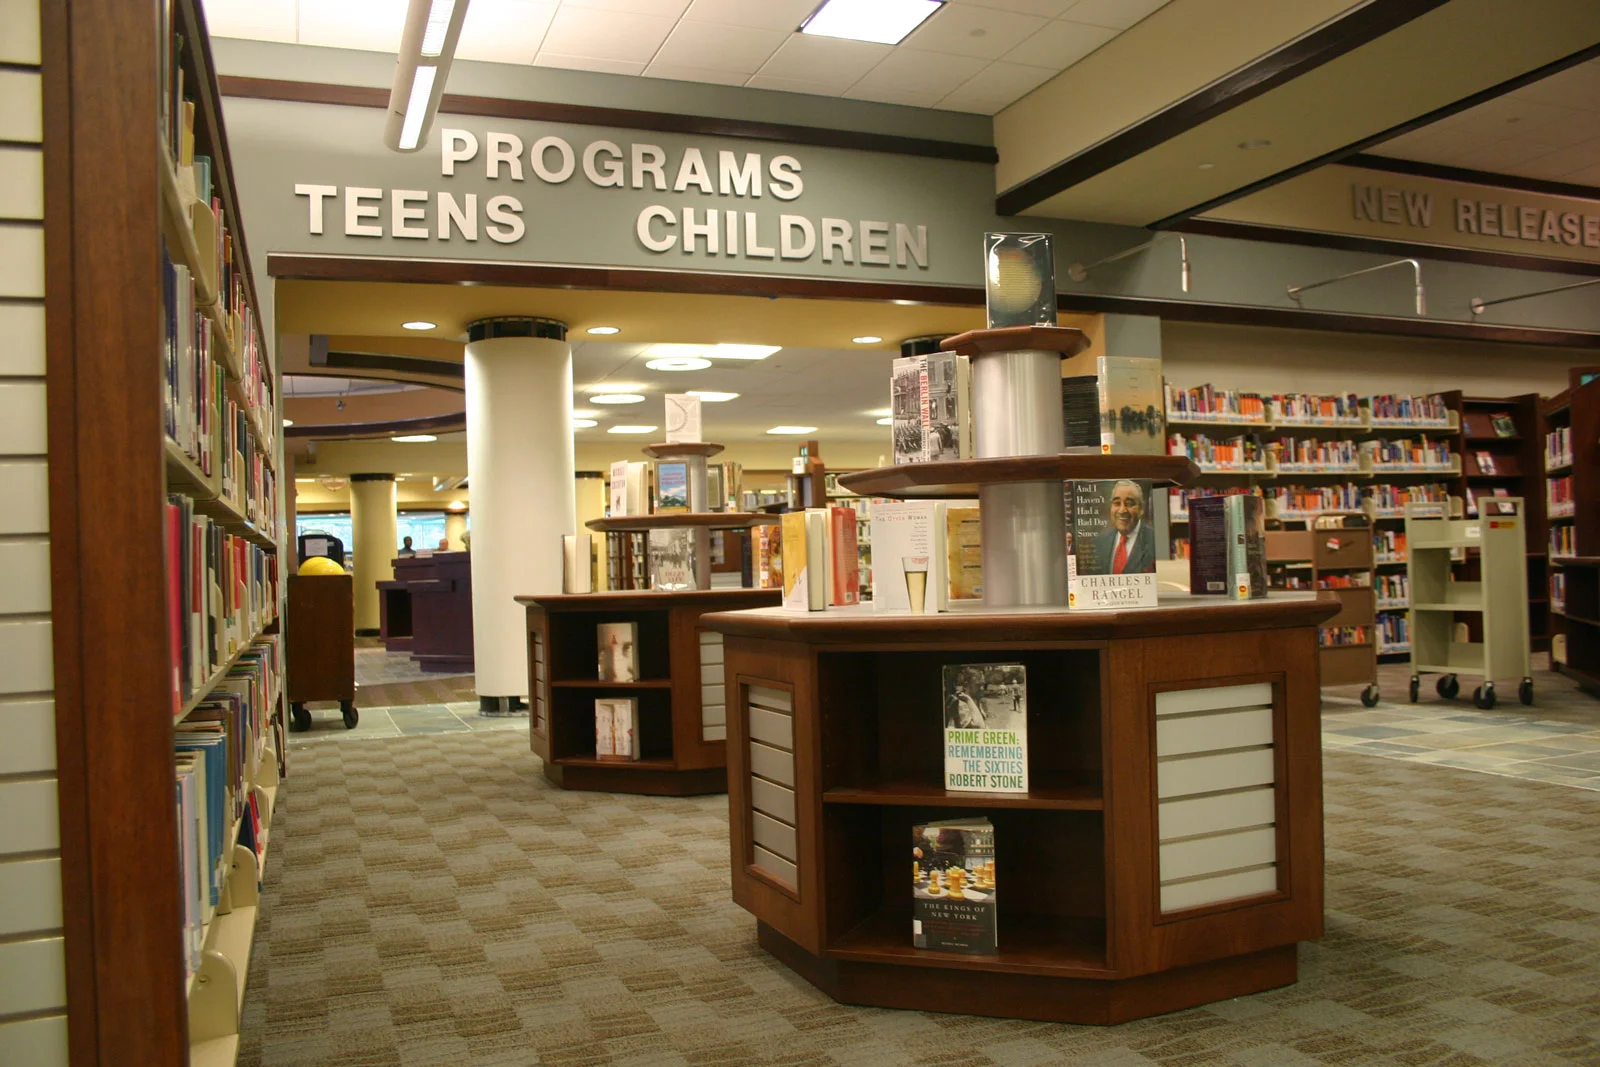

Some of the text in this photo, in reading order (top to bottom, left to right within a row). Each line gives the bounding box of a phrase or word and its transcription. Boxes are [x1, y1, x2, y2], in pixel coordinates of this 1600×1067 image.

[441, 128, 803, 200] PROGRAMS
[1353, 184, 1434, 227] NEW
[295, 183, 525, 244] TEENS
[636, 204, 930, 269] CHILDREN
[920, 358, 928, 374] THE
[920, 375, 929, 405] BERLIN
[921, 407, 930, 428] WALL
[1076, 484, 1097, 493] And I
[1076, 495, 1105, 504] Haven't
[1077, 507, 1093, 515] Had
[1077, 518, 1108, 528] Bad Day
[1077, 529, 1099, 537] Since
[1081, 576, 1140, 588] CHARLES
[1092, 588, 1144, 601] RANGEL
[948, 730, 1020, 745] PRIME GREEN:
[948, 745, 1023, 760] REMEMBERING
[962, 759, 1023, 774] THE SIXTIES
[949, 773, 1023, 789] ROBERT STONE
[944, 903, 970, 912] KINGS
[953, 913, 977, 921] YORK
